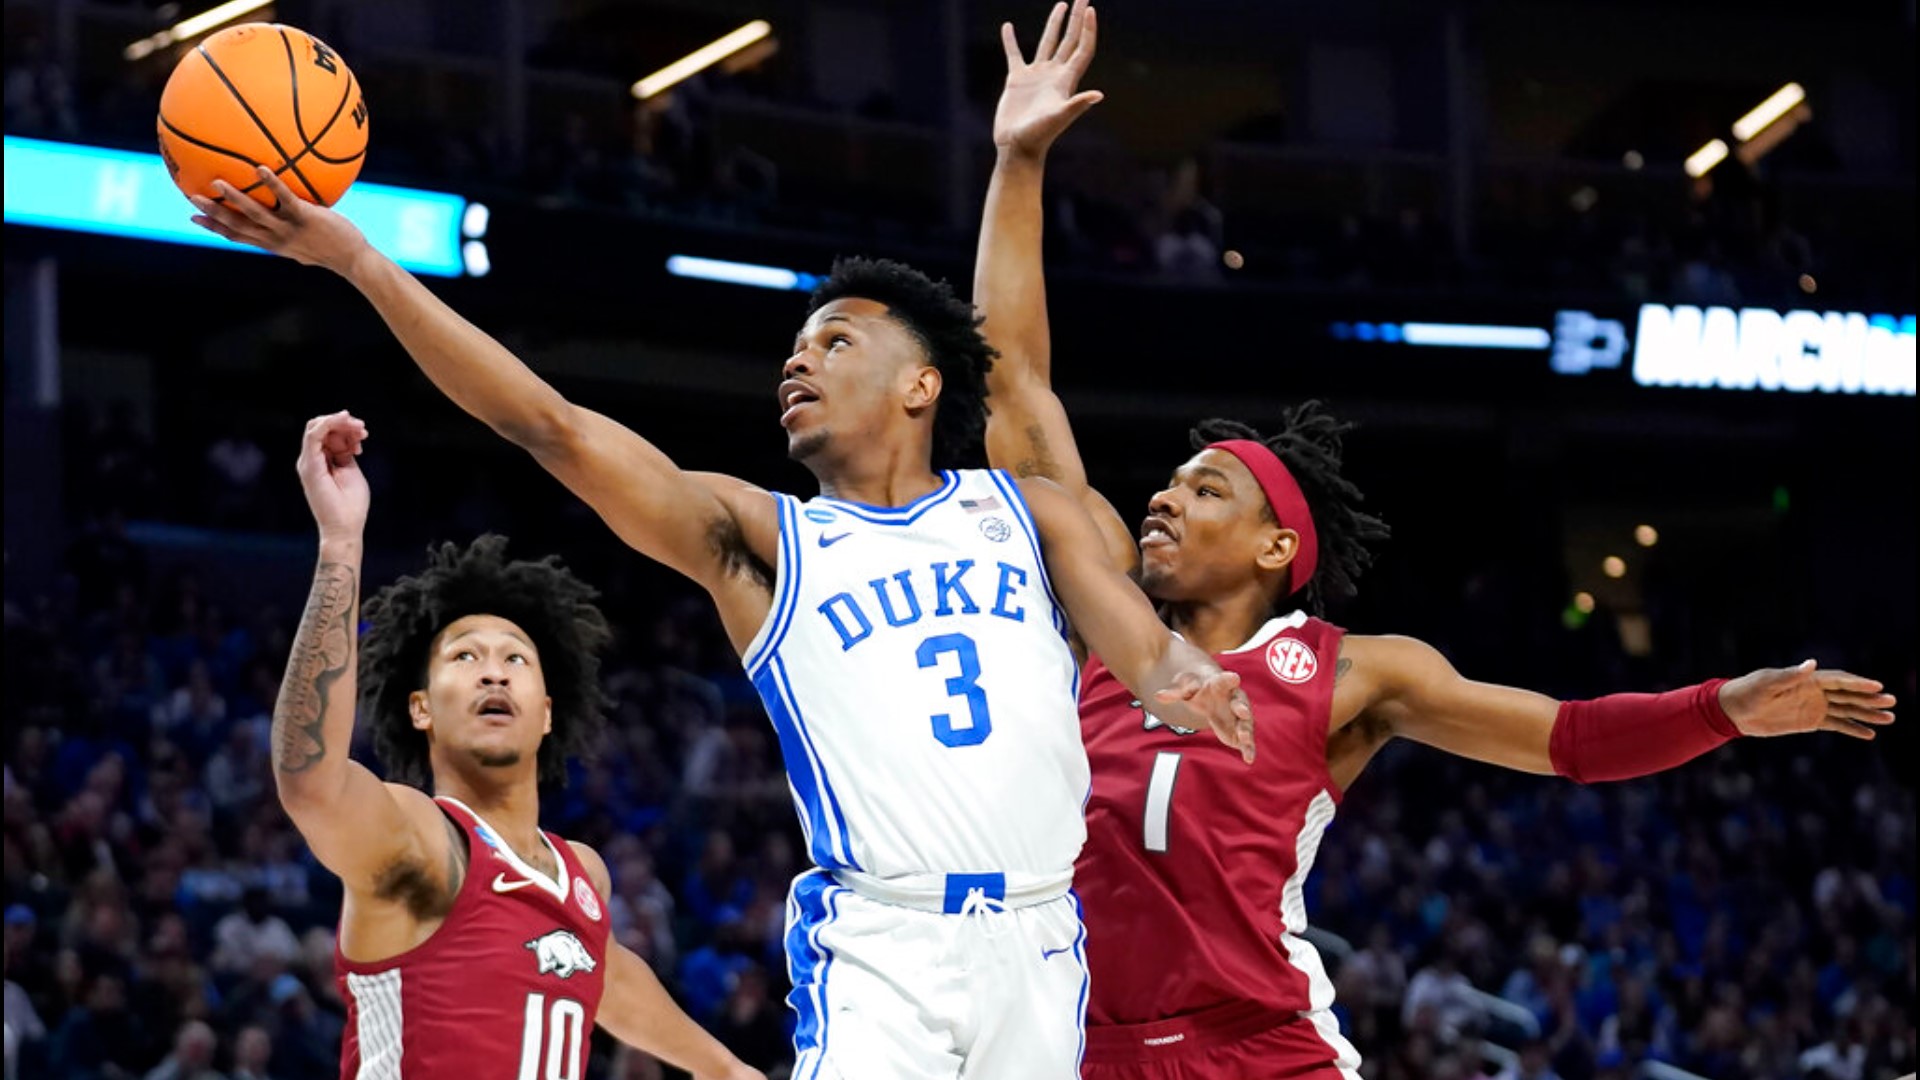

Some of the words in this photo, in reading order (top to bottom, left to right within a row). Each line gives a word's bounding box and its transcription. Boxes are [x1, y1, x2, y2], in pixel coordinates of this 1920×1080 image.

[817, 559, 1027, 652] DUKE
[915, 632, 992, 748] 3
[1269, 640, 1314, 680] SEC
[1142, 750, 1182, 853] 1
[517, 992, 586, 1080] 10
